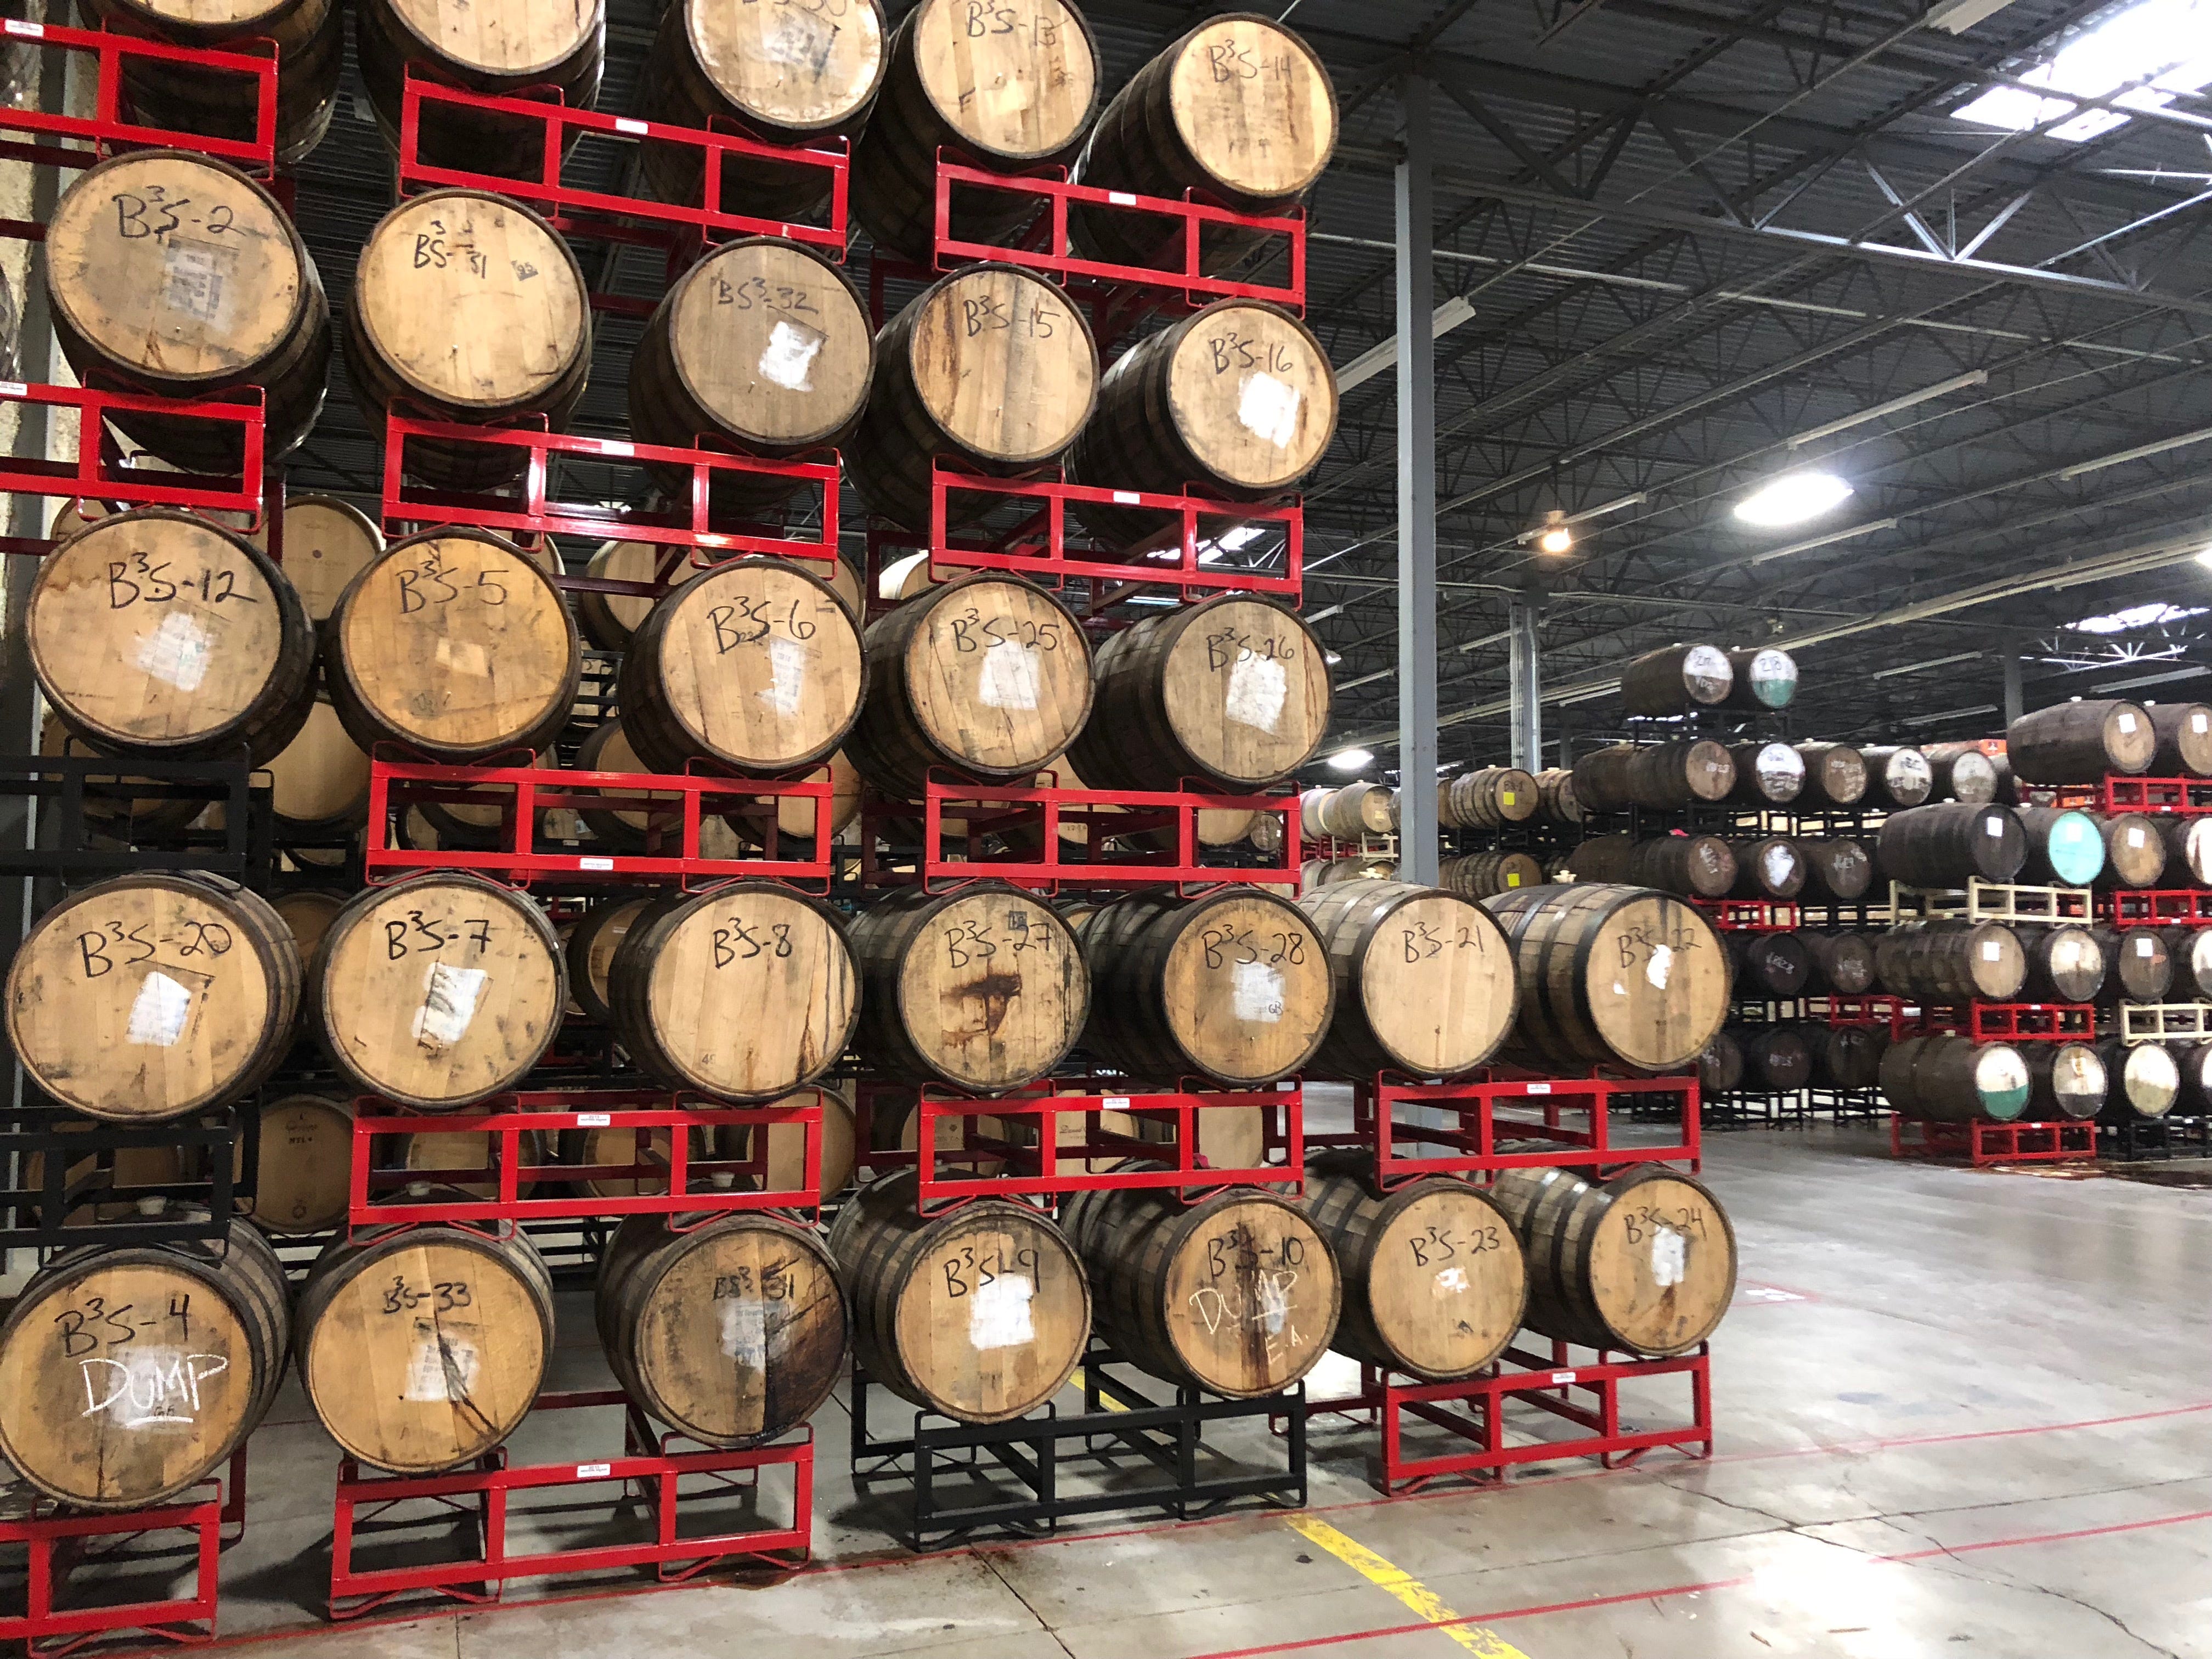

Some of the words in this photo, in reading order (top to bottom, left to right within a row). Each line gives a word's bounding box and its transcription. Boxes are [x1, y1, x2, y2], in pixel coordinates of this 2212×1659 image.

[111, 185, 246, 244] B3S-2
[963, 295, 1061, 338] B3S-15
[1209, 332, 1293, 375] B3S-16
[109, 551, 258, 610] B3S-12
[395, 560, 509, 614] B3S-5
[706, 596, 816, 654] B3S-6
[951, 608, 1060, 652] B3S-25
[76, 921, 232, 978] B3S-20
[385, 910, 492, 960] B3S-7
[713, 917, 793, 969] B3S-8
[944, 920, 1052, 968] B3S-27
[1201, 924, 1305, 969] B3S-28
[1402, 921, 1484, 963] B3S-21
[944, 1247, 1040, 1297] B3S-9
[1410, 1227, 1500, 1267] B3S-23
[54, 1294, 190, 1358] B3S-4
[78, 1353, 229, 1417] DUMP
